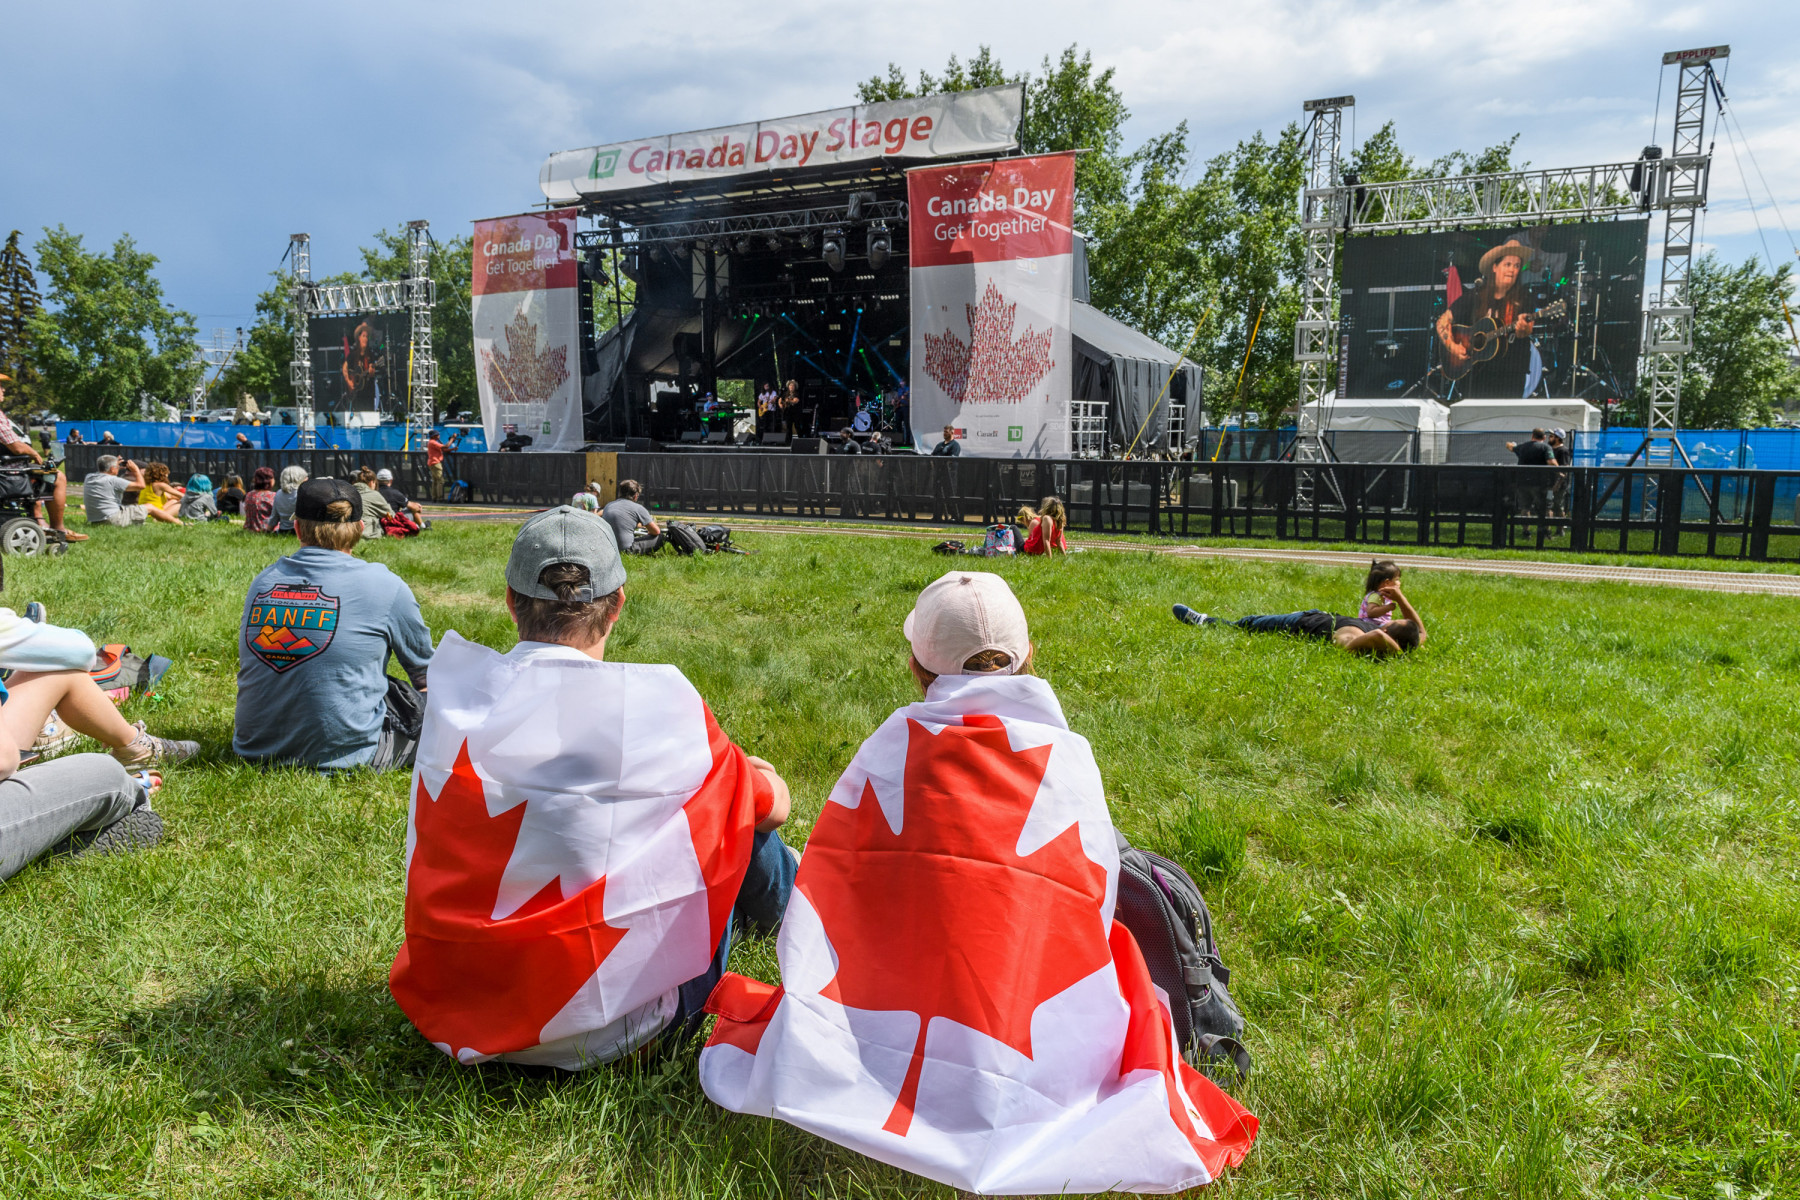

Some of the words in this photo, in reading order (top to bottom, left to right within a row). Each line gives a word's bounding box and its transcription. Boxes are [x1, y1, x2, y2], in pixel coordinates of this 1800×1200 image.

[1676, 48, 1717, 60] APPLIED
[628, 134, 745, 174] Canada
[755, 128, 819, 167] Day
[826, 115, 934, 152] Stage
[927, 190, 1007, 217] Canada
[1014, 187, 1056, 211] Day
[934, 223, 965, 241] Get
[968, 216, 1047, 241] Together
[483, 236, 531, 256] Canada
[534, 234, 562, 252] Day
[486, 260, 505, 275] Get
[507, 255, 557, 275] Together
[251, 607, 333, 628] BANFF
